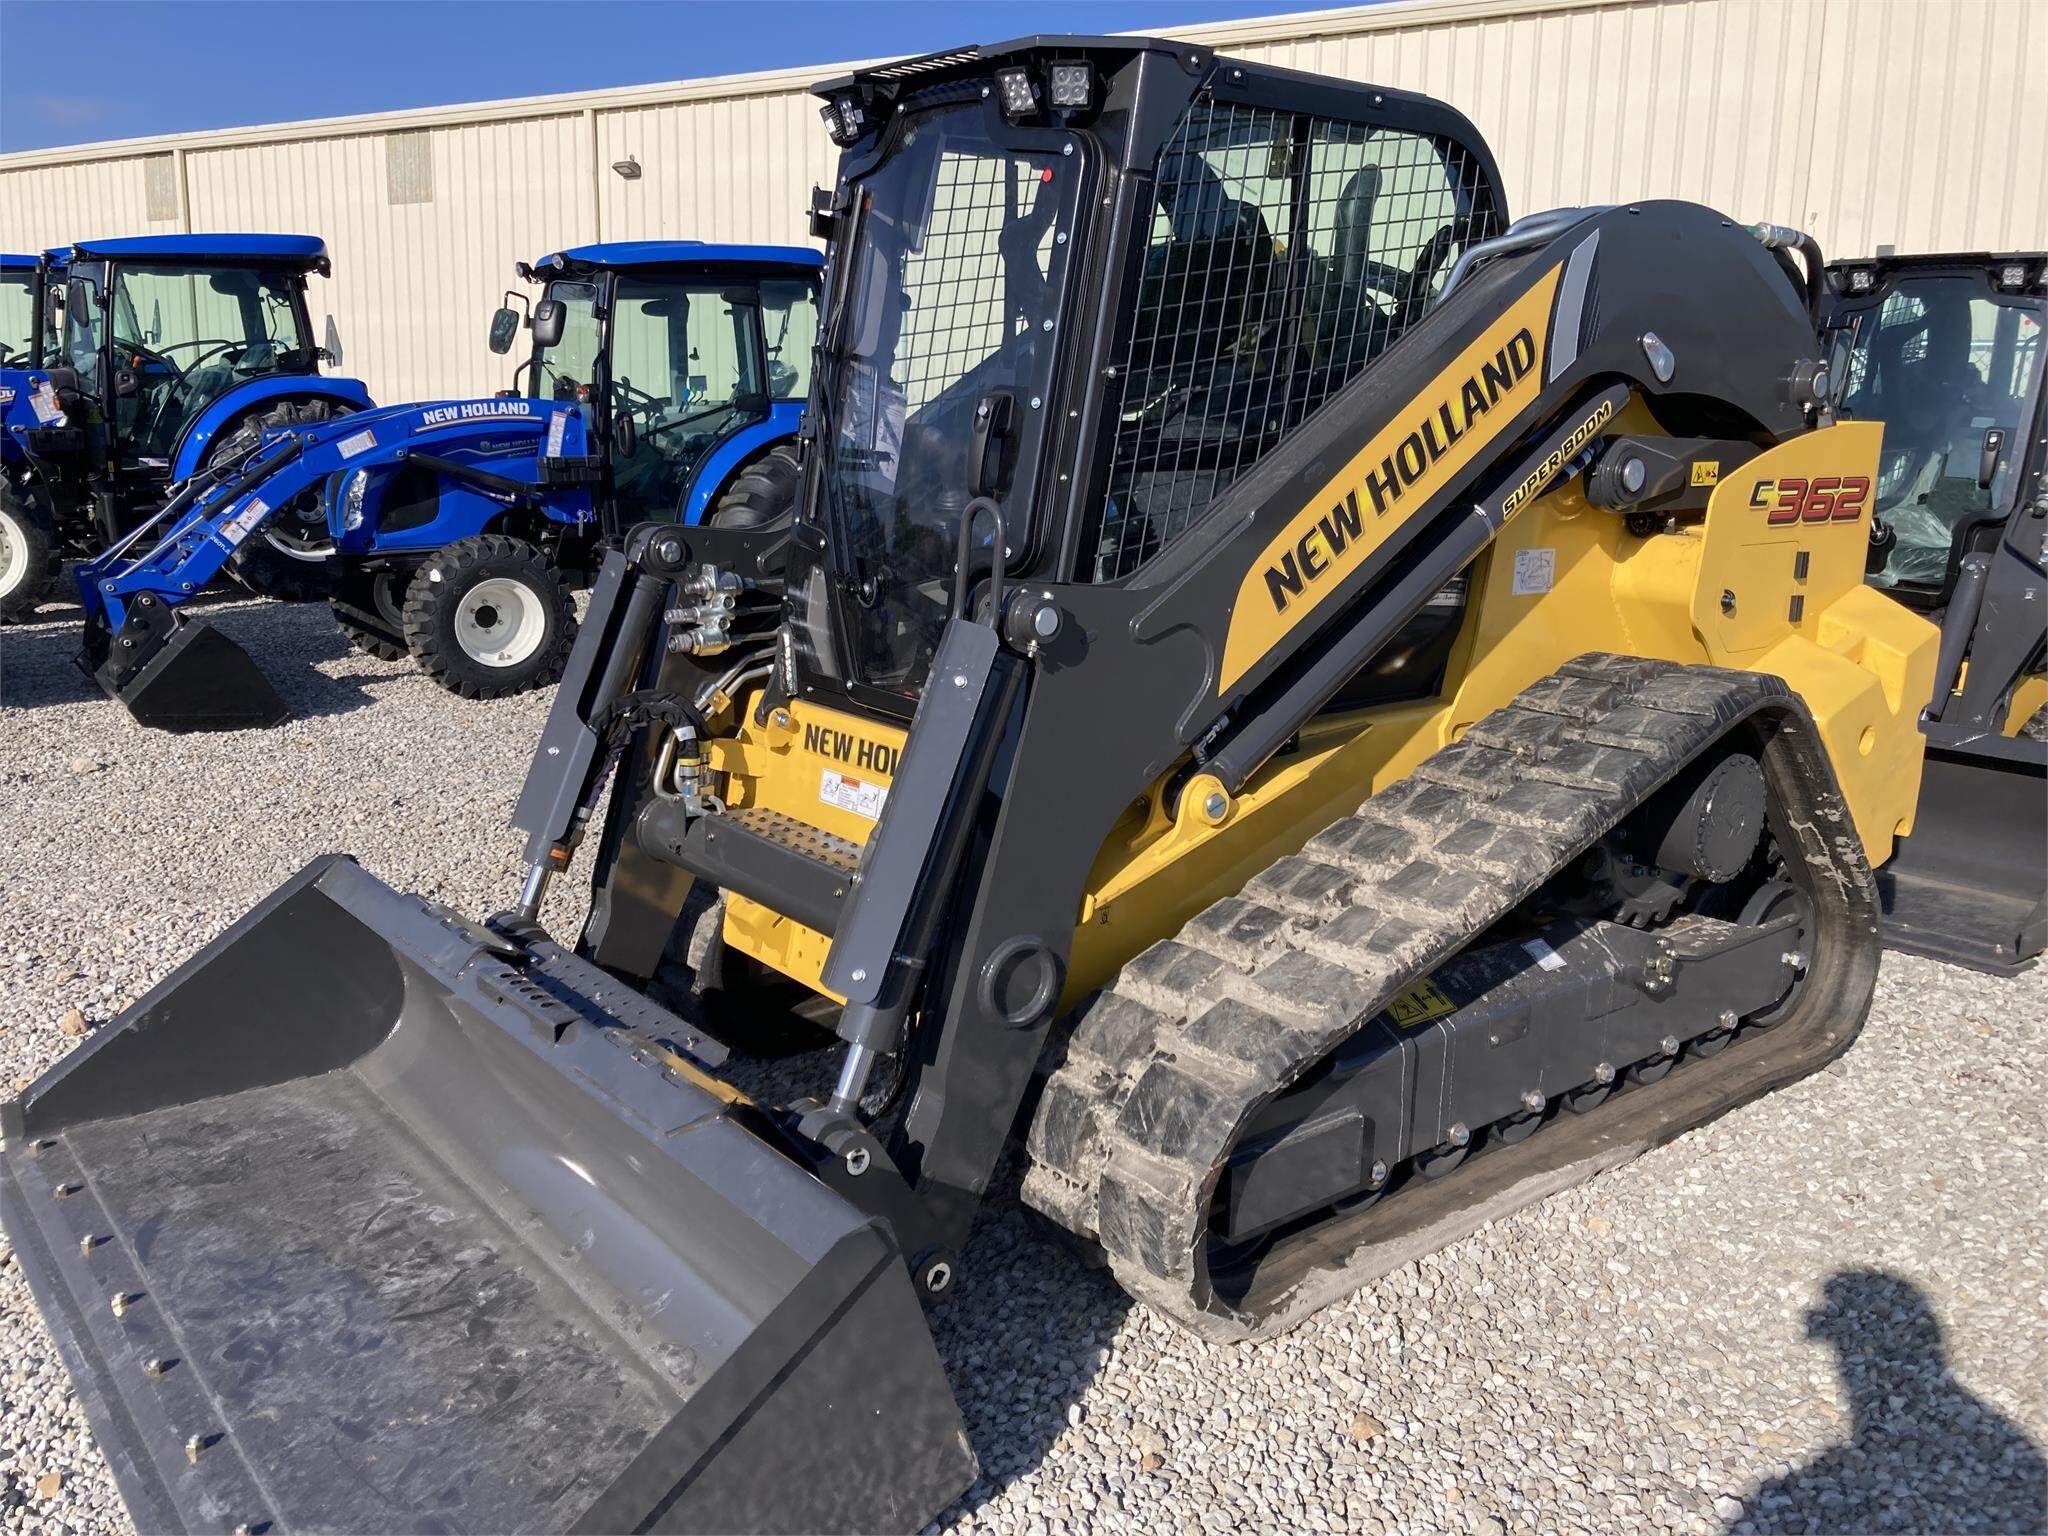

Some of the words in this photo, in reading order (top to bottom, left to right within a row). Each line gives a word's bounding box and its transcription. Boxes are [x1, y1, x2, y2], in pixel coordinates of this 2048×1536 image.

[423, 406, 458, 425] NEW
[460, 402, 530, 417] HOLLAND
[1263, 486, 1365, 615] NEW
[1364, 327, 1539, 518] HOLLAND
[1503, 451, 1562, 520] SUPER
[1561, 400, 1613, 461] BOOM
[1749, 476, 1871, 527] C362
[803, 723, 854, 763] NEW
